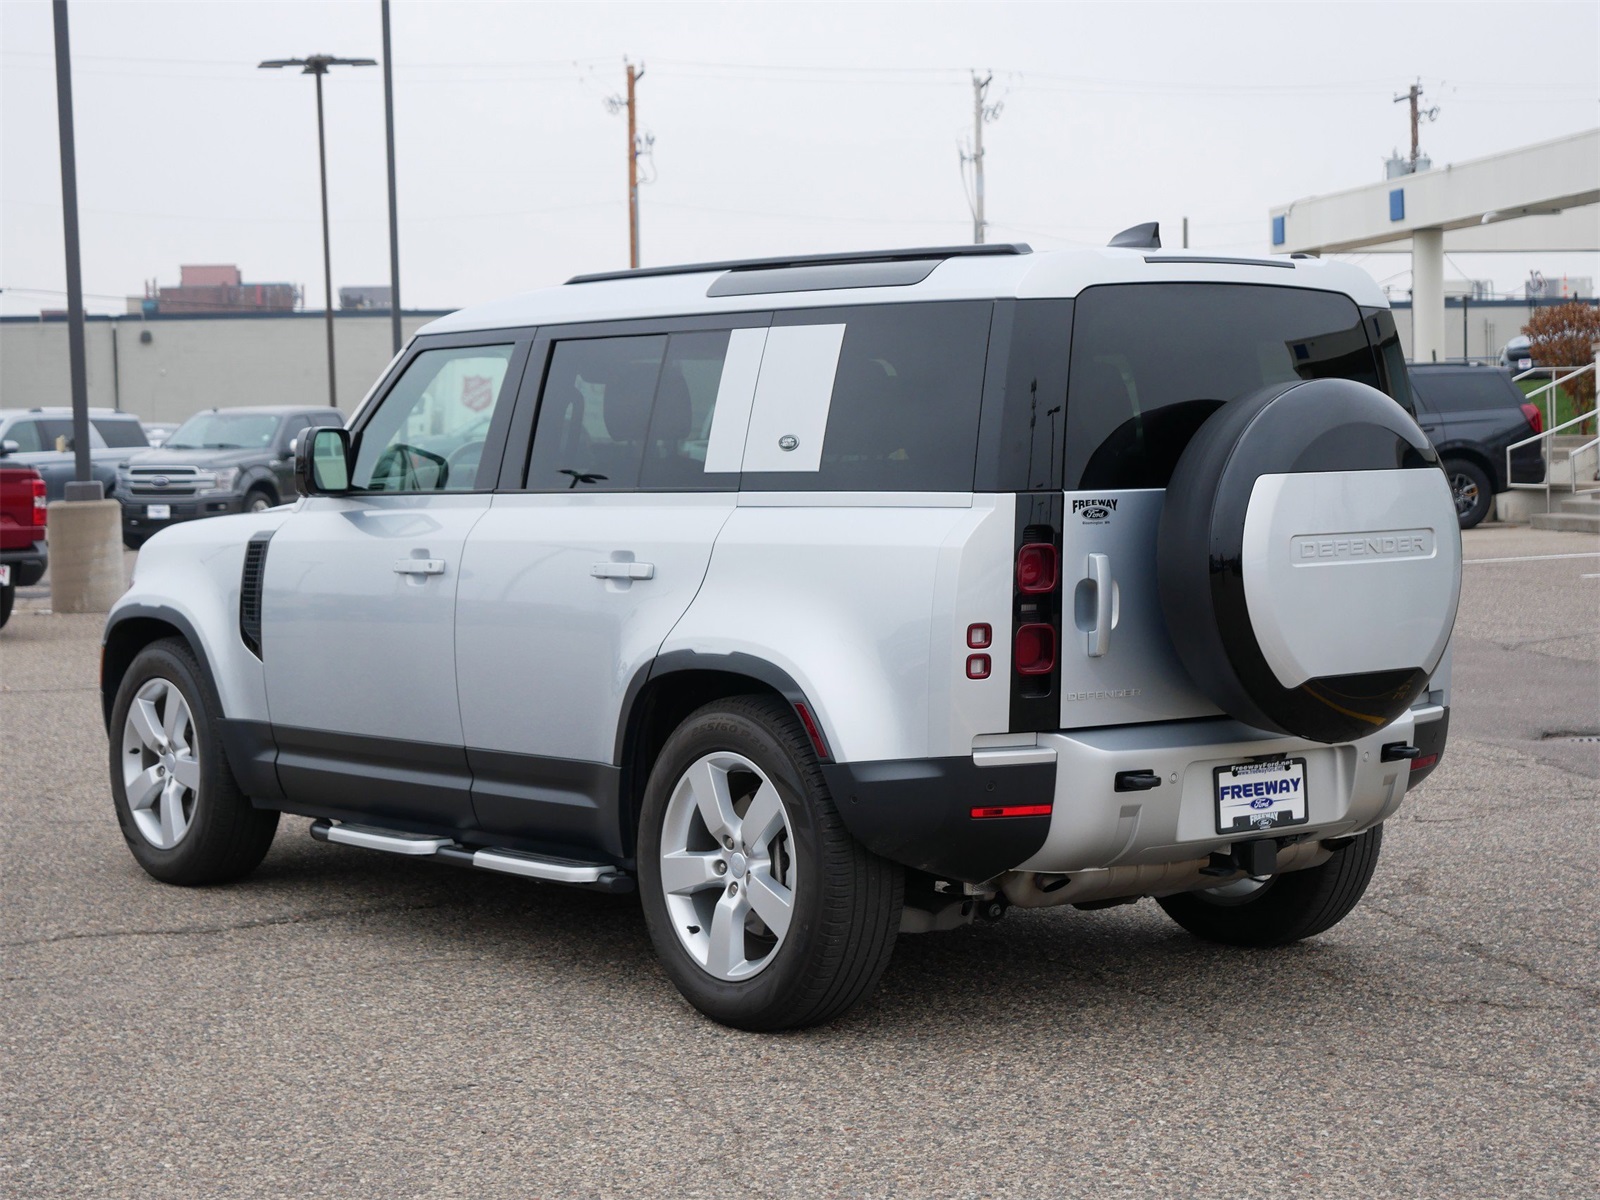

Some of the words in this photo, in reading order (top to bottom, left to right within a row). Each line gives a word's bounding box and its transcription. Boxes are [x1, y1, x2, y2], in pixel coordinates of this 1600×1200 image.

[1072, 499, 1118, 514] FREEWAY
[1300, 535, 1424, 559] DEFENDER
[1067, 688, 1142, 702] DEFENDER
[1231, 760, 1293, 772] FreewayFord.net
[1220, 777, 1301, 801] FREEWAY
[1252, 798, 1272, 809] Ford
